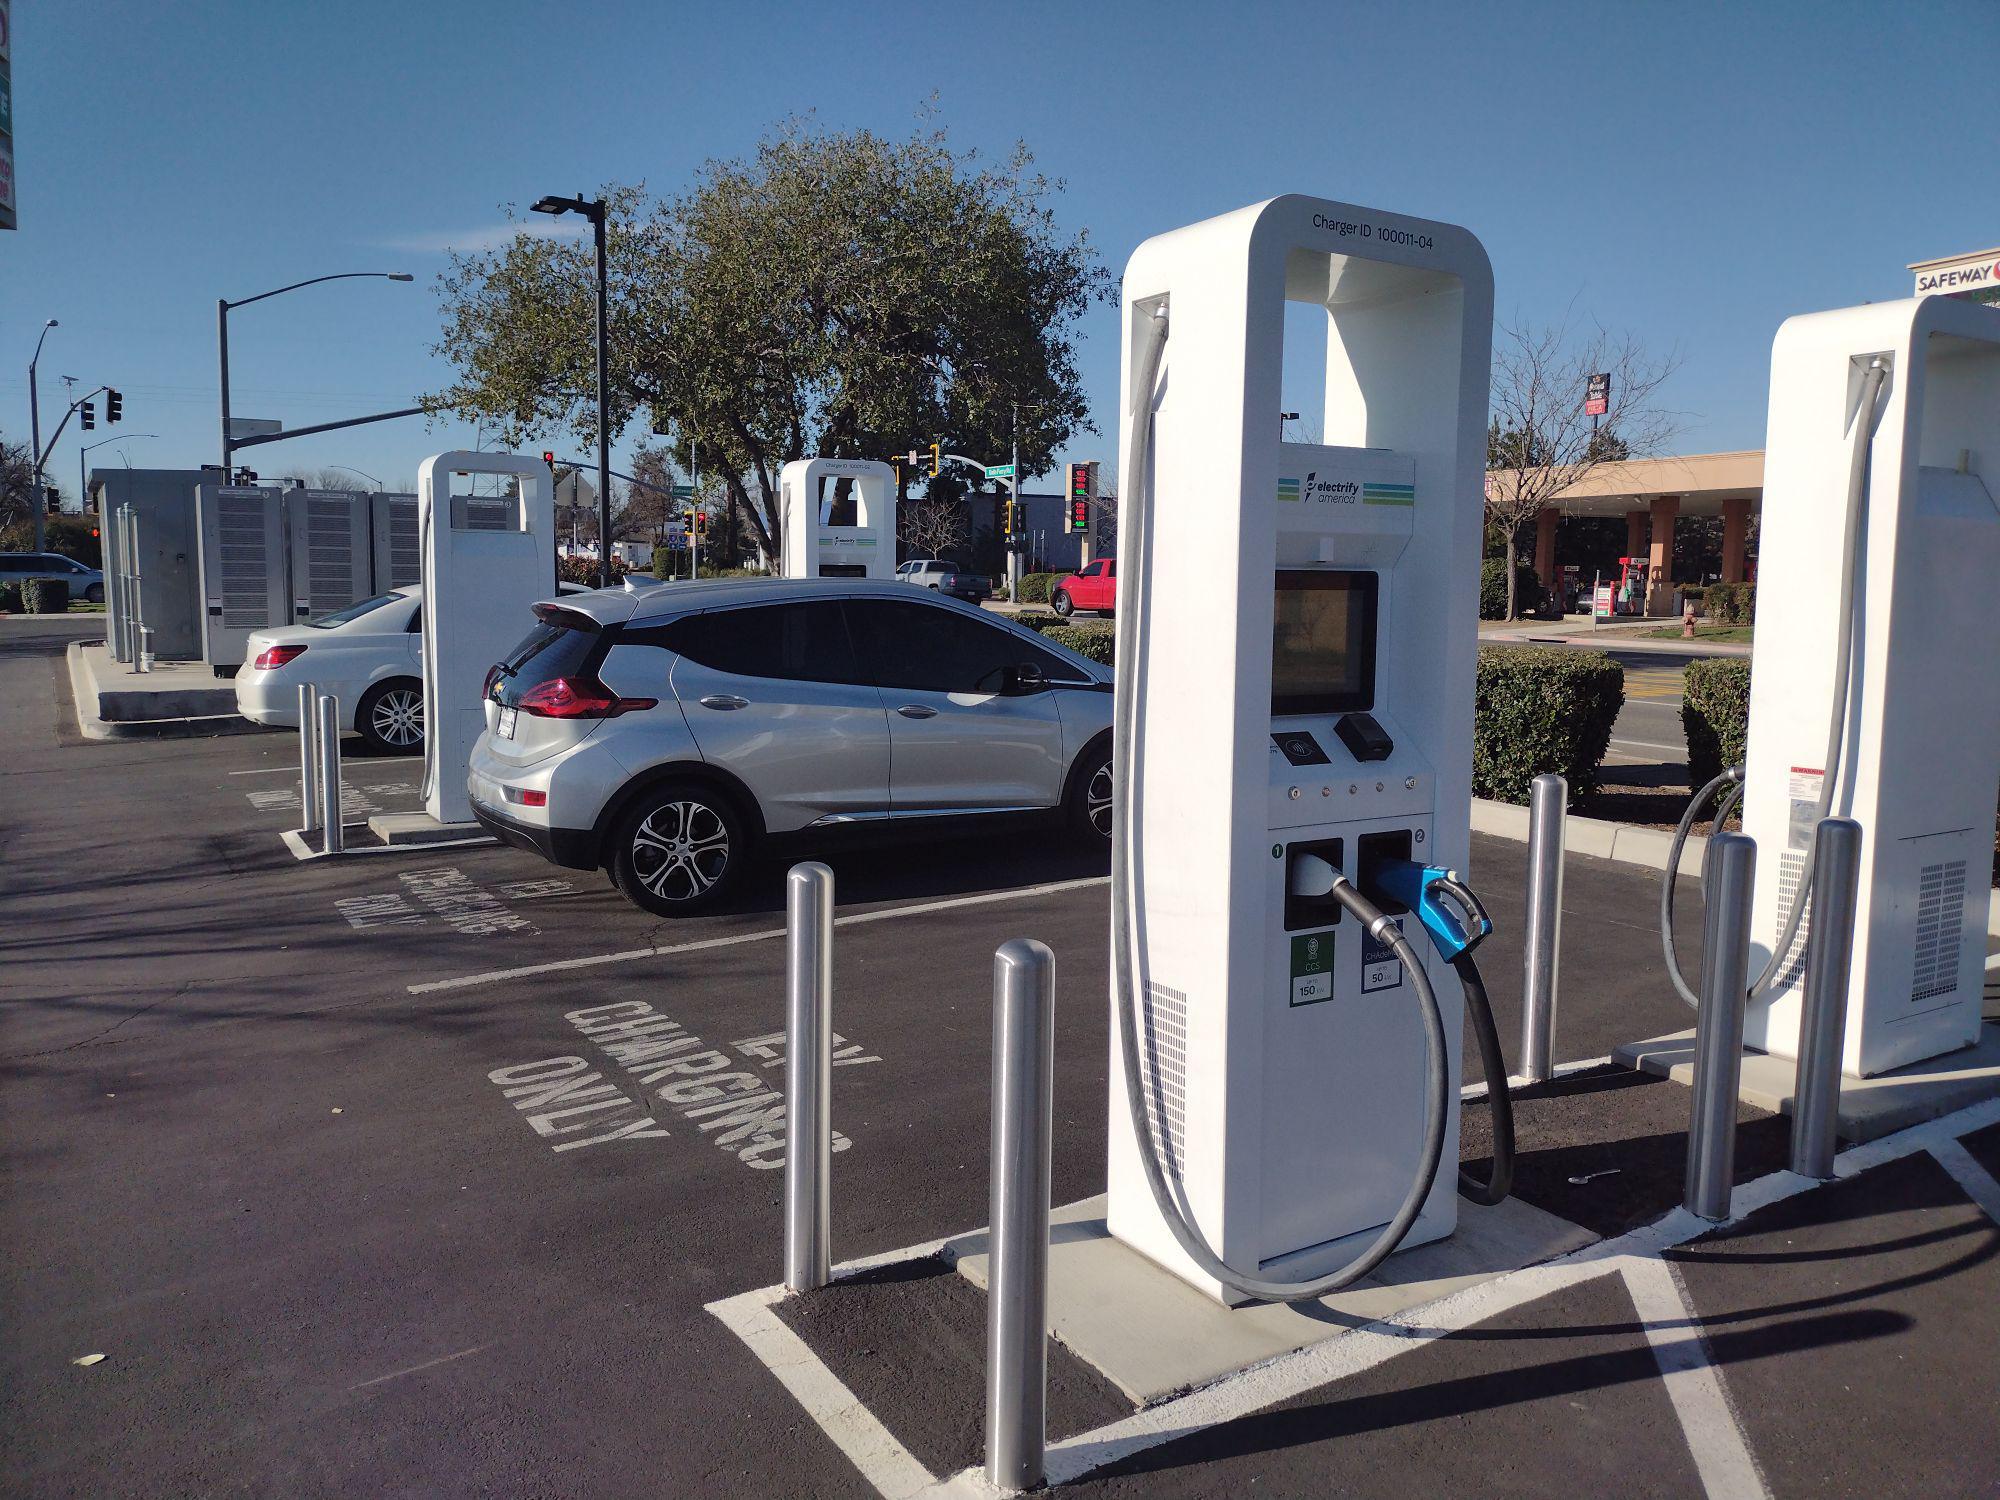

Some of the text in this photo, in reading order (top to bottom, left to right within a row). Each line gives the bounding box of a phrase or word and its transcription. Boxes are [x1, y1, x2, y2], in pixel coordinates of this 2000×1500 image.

[1312, 214, 1433, 250] Charger ID 100011-04
[1918, 265, 1992, 291] SAFEWAY
[1317, 480, 1359, 495] electrify
[1318, 493, 1356, 504] america
[1797, 767, 1825, 776] WARNIN
[1365, 950, 1398, 961] CHAdeM
[1305, 962, 1321, 972] CCS
[1372, 973, 1383, 983] 50
[1299, 985, 1316, 996] 150
[564, 1000, 852, 1170] CHARGING
[487, 1055, 671, 1153] ONLY
